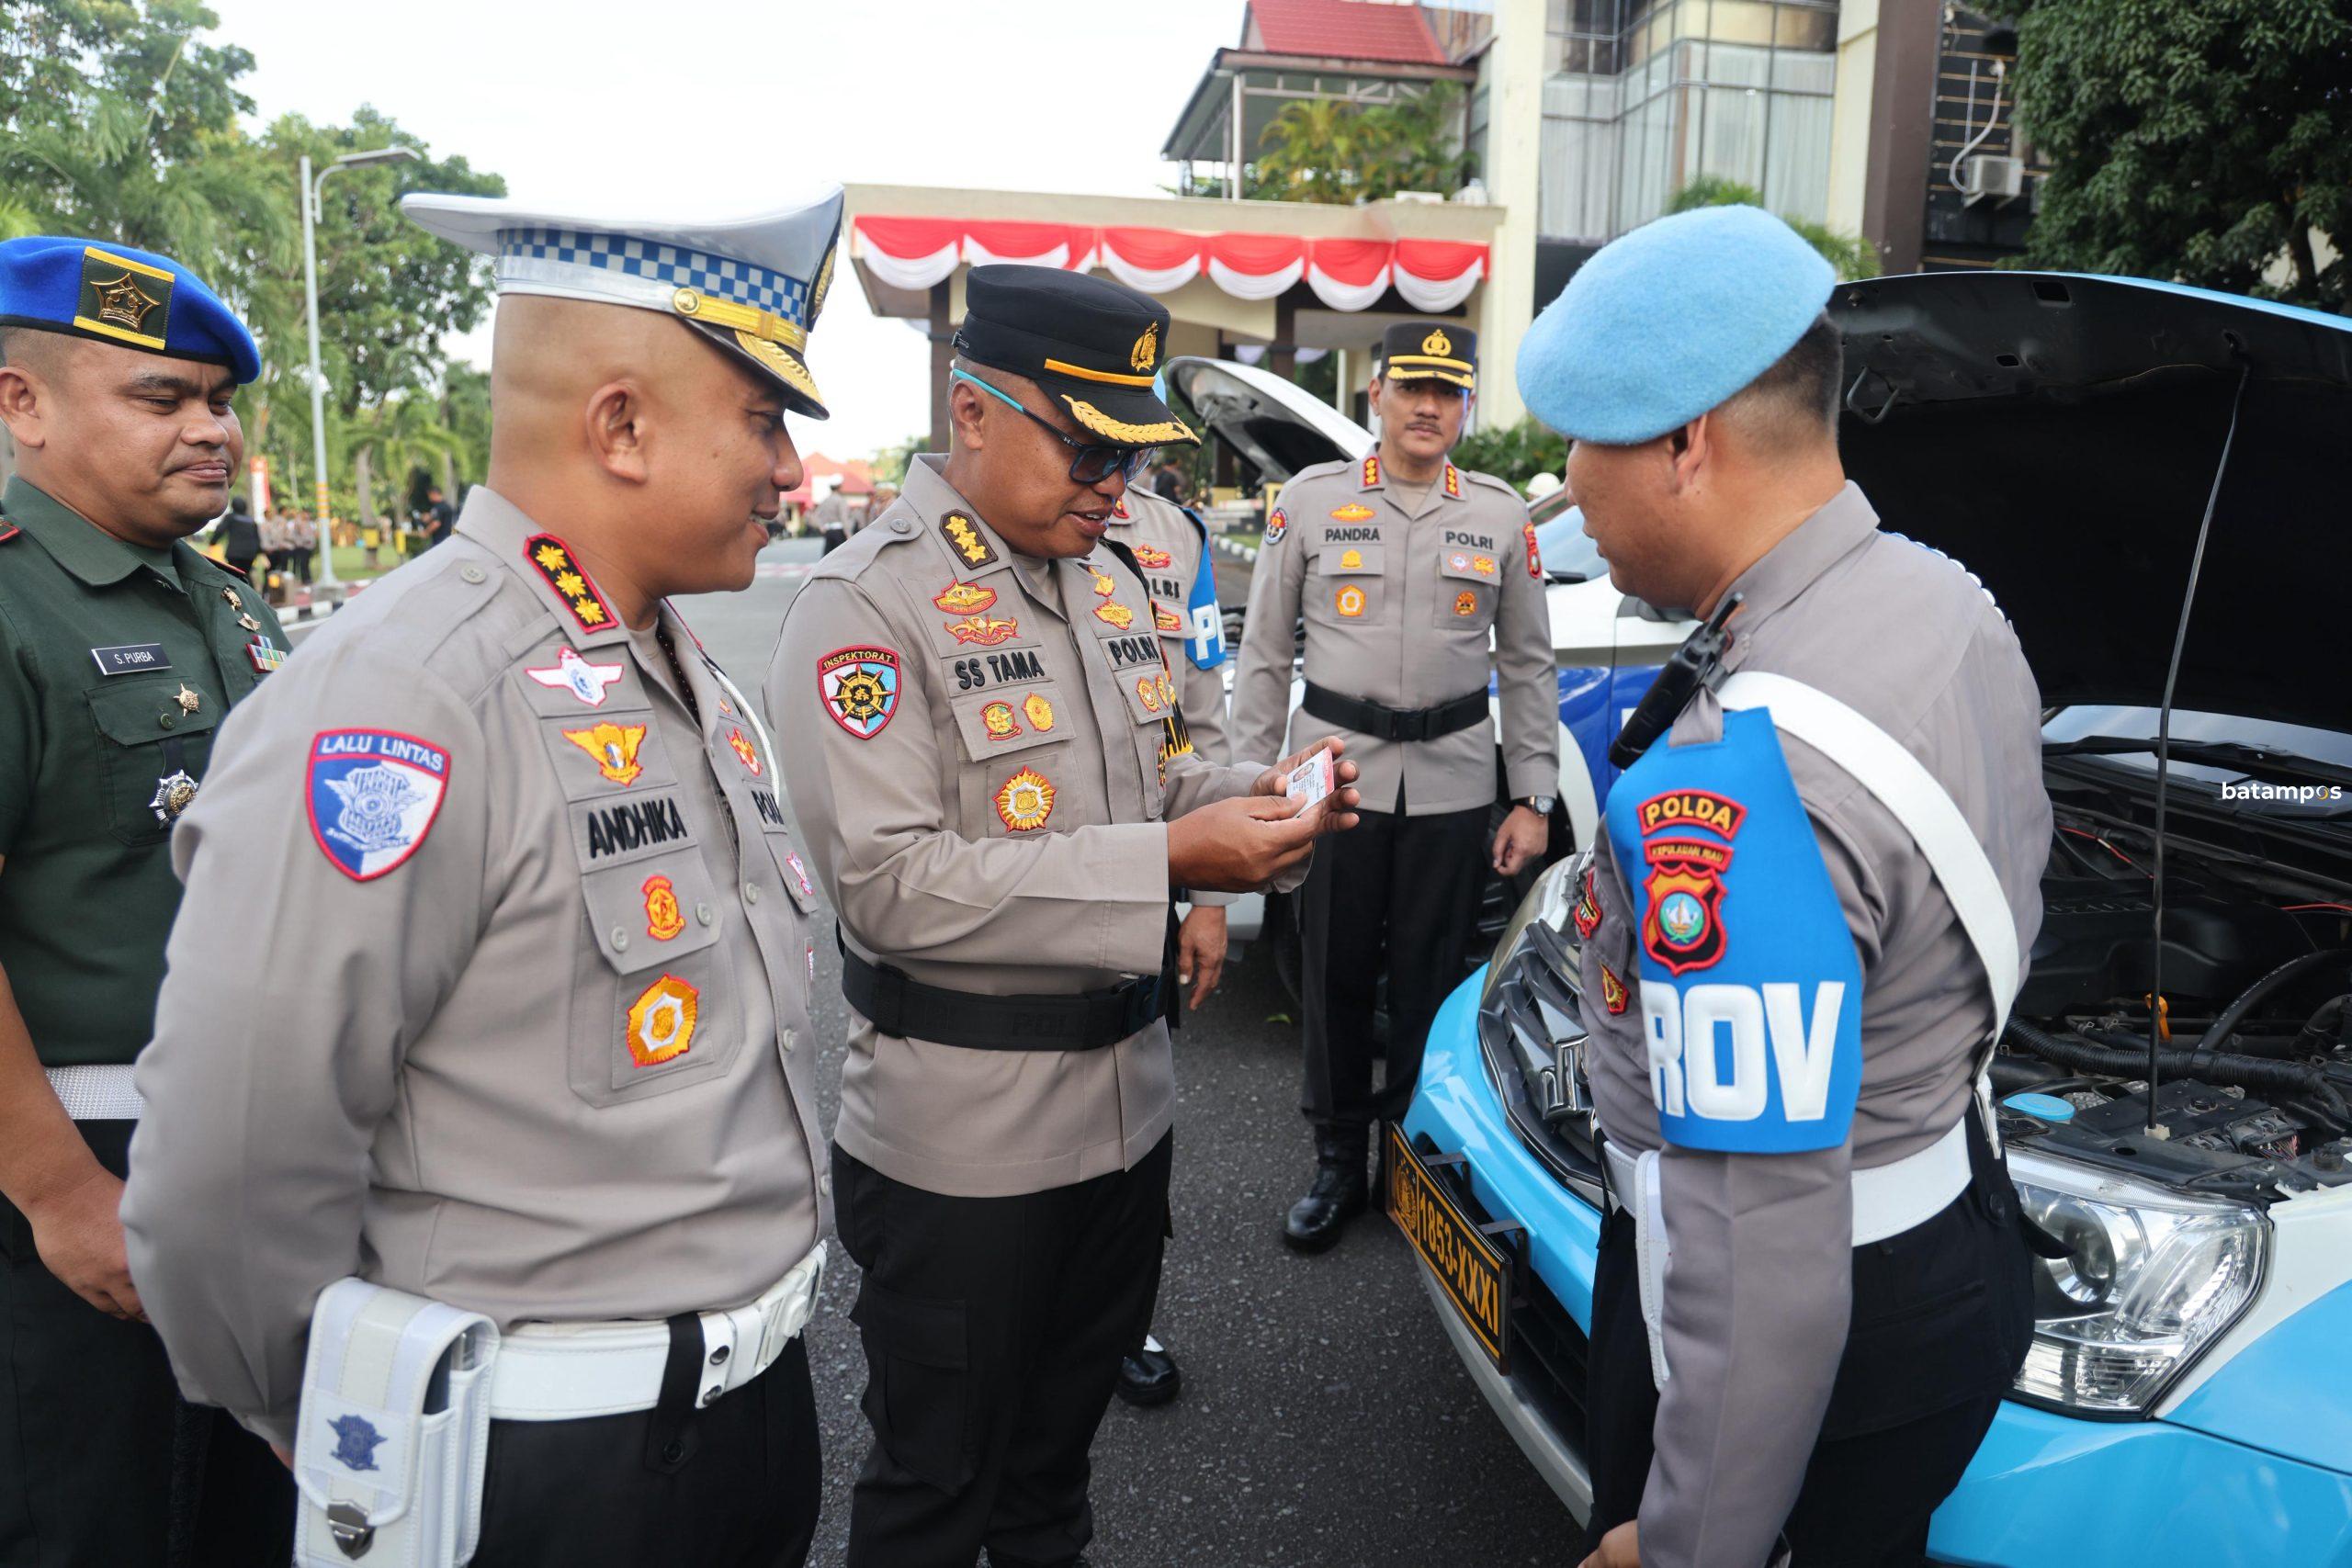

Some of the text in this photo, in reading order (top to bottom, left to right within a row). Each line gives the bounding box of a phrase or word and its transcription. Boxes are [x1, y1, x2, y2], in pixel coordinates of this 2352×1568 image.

[1326, 527, 1381, 543] PANDRA
[1445, 531, 1493, 550] POLRI
[1147, 578, 1180, 598] LRI
[114, 651, 154, 665] S. PURBA
[823, 650, 893, 670] INSPEKTORAT
[1108, 636, 1159, 666] POLRI
[954, 650, 1046, 690] SS TAMA
[322, 735, 444, 773] LALU LINTAS
[1646, 795, 1731, 831] POLDA
[587, 797, 688, 860] ANDHIKA
[1420, 1191, 1498, 1337] 1853-XXXI
